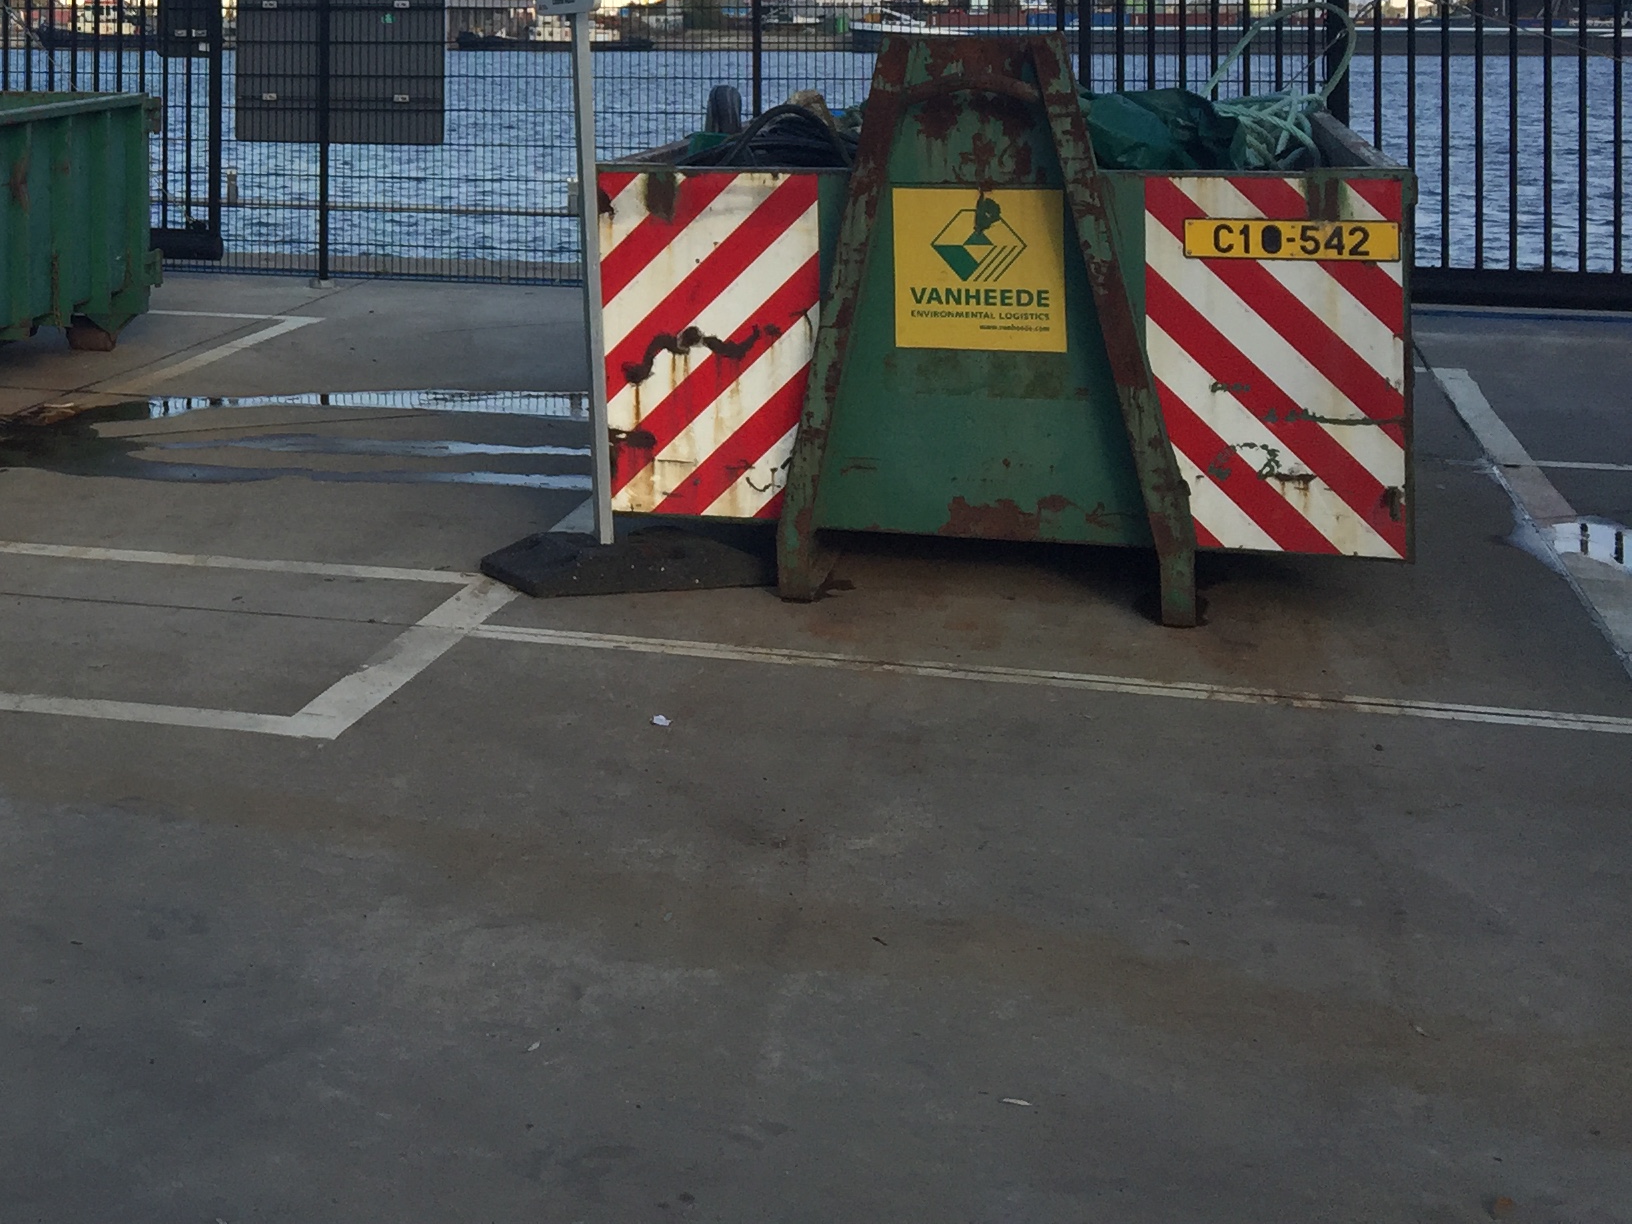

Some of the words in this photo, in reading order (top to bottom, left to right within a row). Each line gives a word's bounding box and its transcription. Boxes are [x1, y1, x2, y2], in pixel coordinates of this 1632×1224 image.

[909, 286, 1051, 308] VANHEEDE
[910, 309, 996, 320] ENVIRONMENTAL
[998, 312, 1051, 322] LOGISTICS
